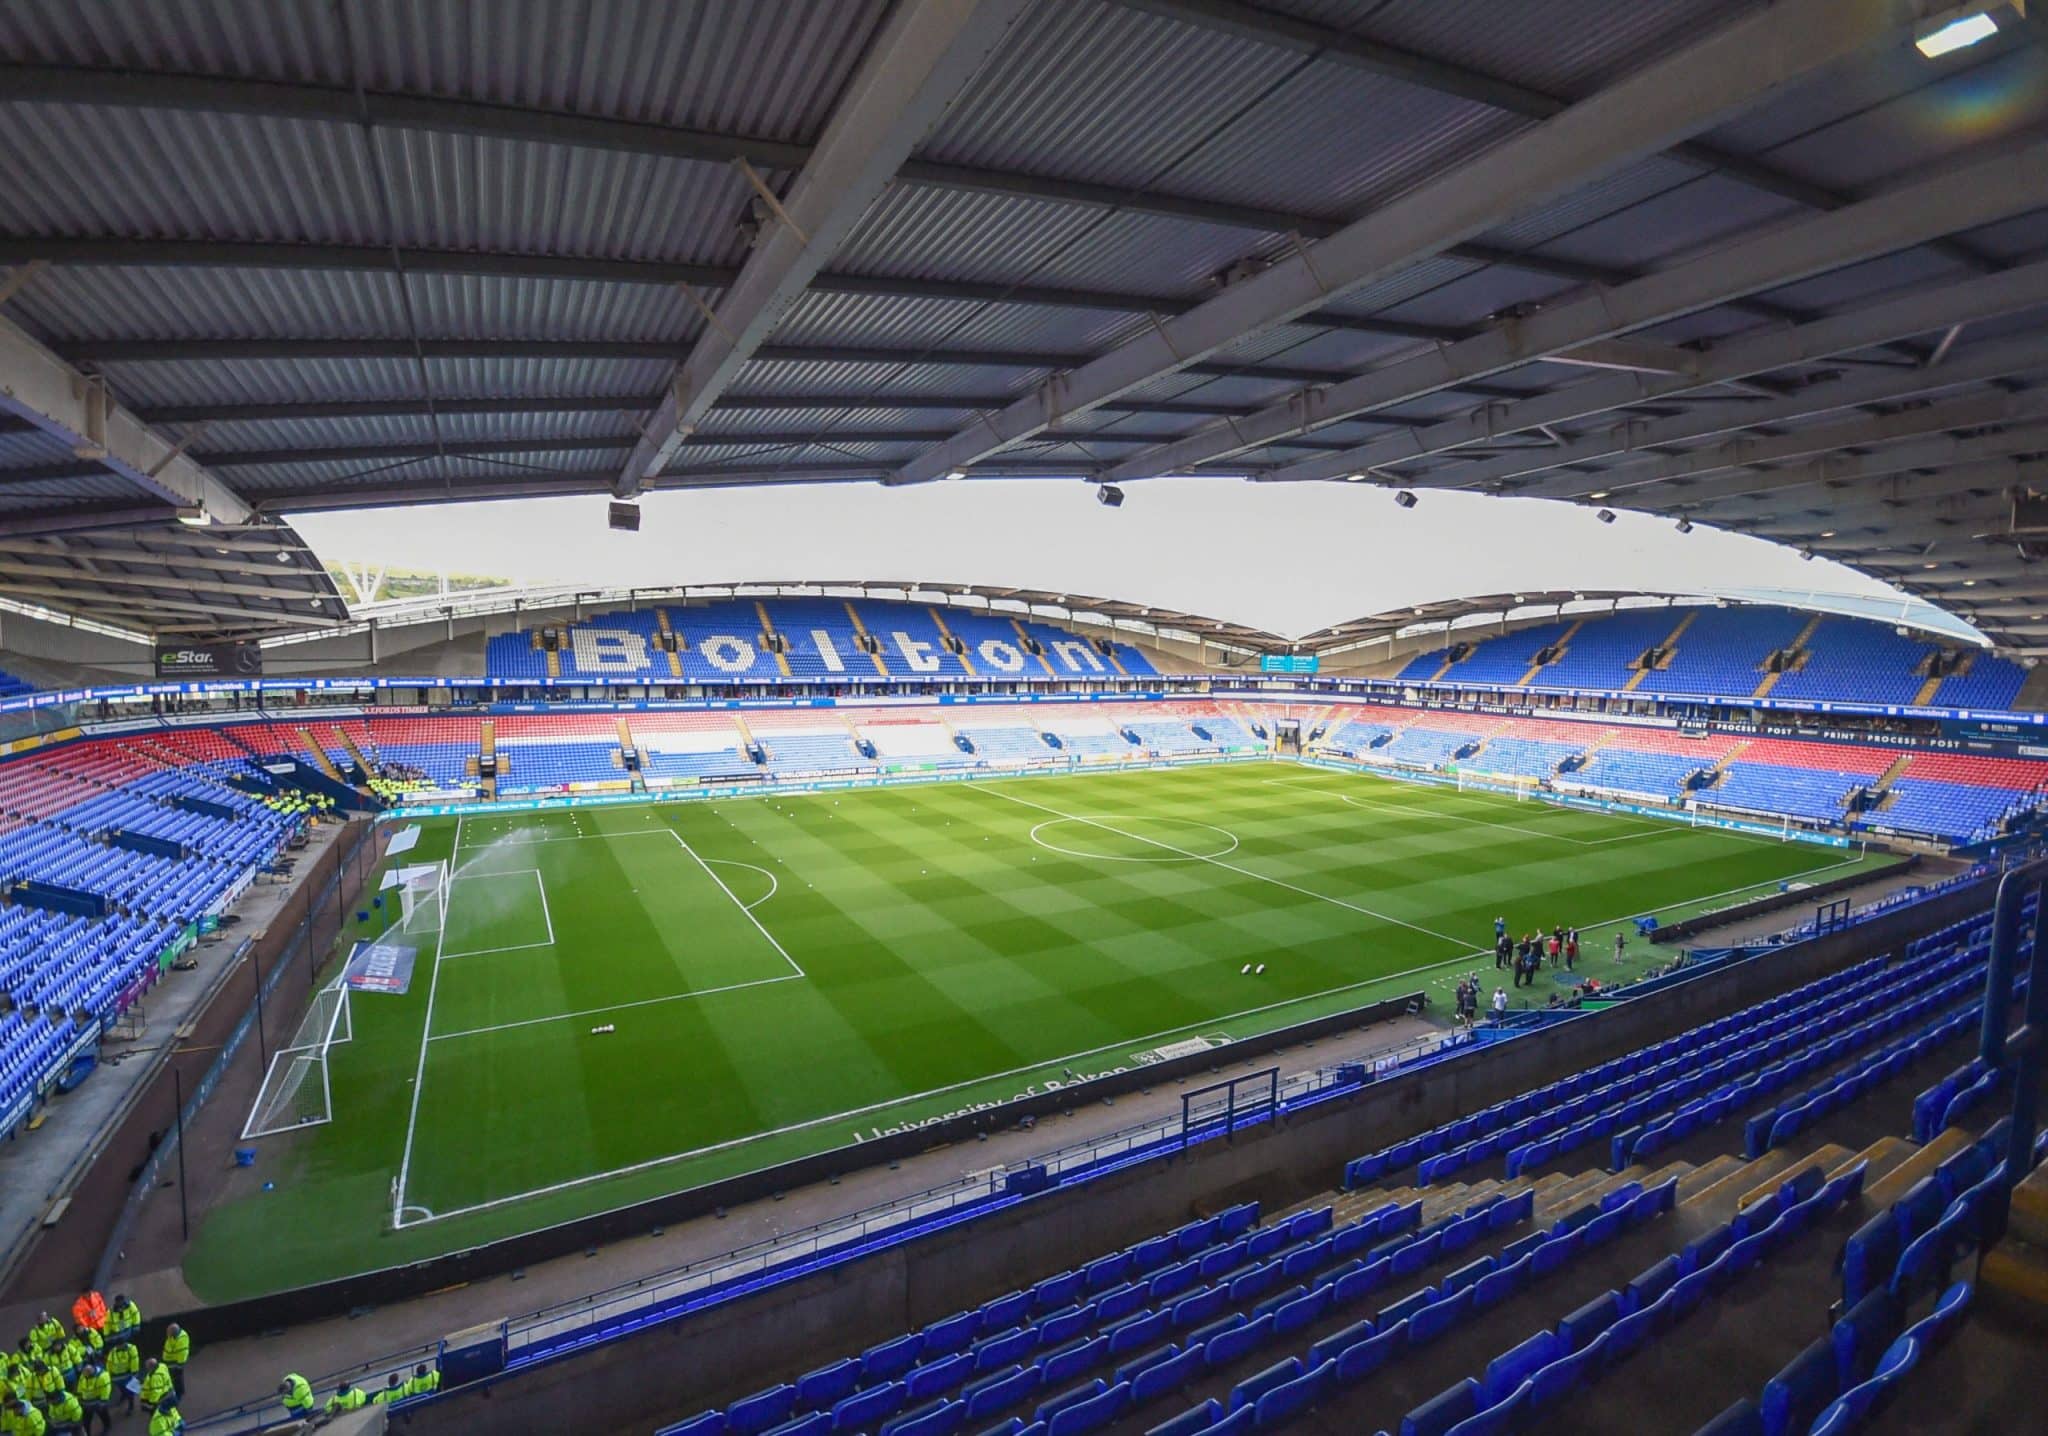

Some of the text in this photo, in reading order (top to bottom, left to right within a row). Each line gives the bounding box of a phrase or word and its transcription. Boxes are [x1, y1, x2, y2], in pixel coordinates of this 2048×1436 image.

[571, 628, 1106, 673] Bolton
[1681, 720, 1792, 735] PRINT PROCESS POST
[1823, 731, 1855, 740] PRINT
[1867, 734, 1917, 746] PROCESS
[1929, 739, 1961, 749] POST
